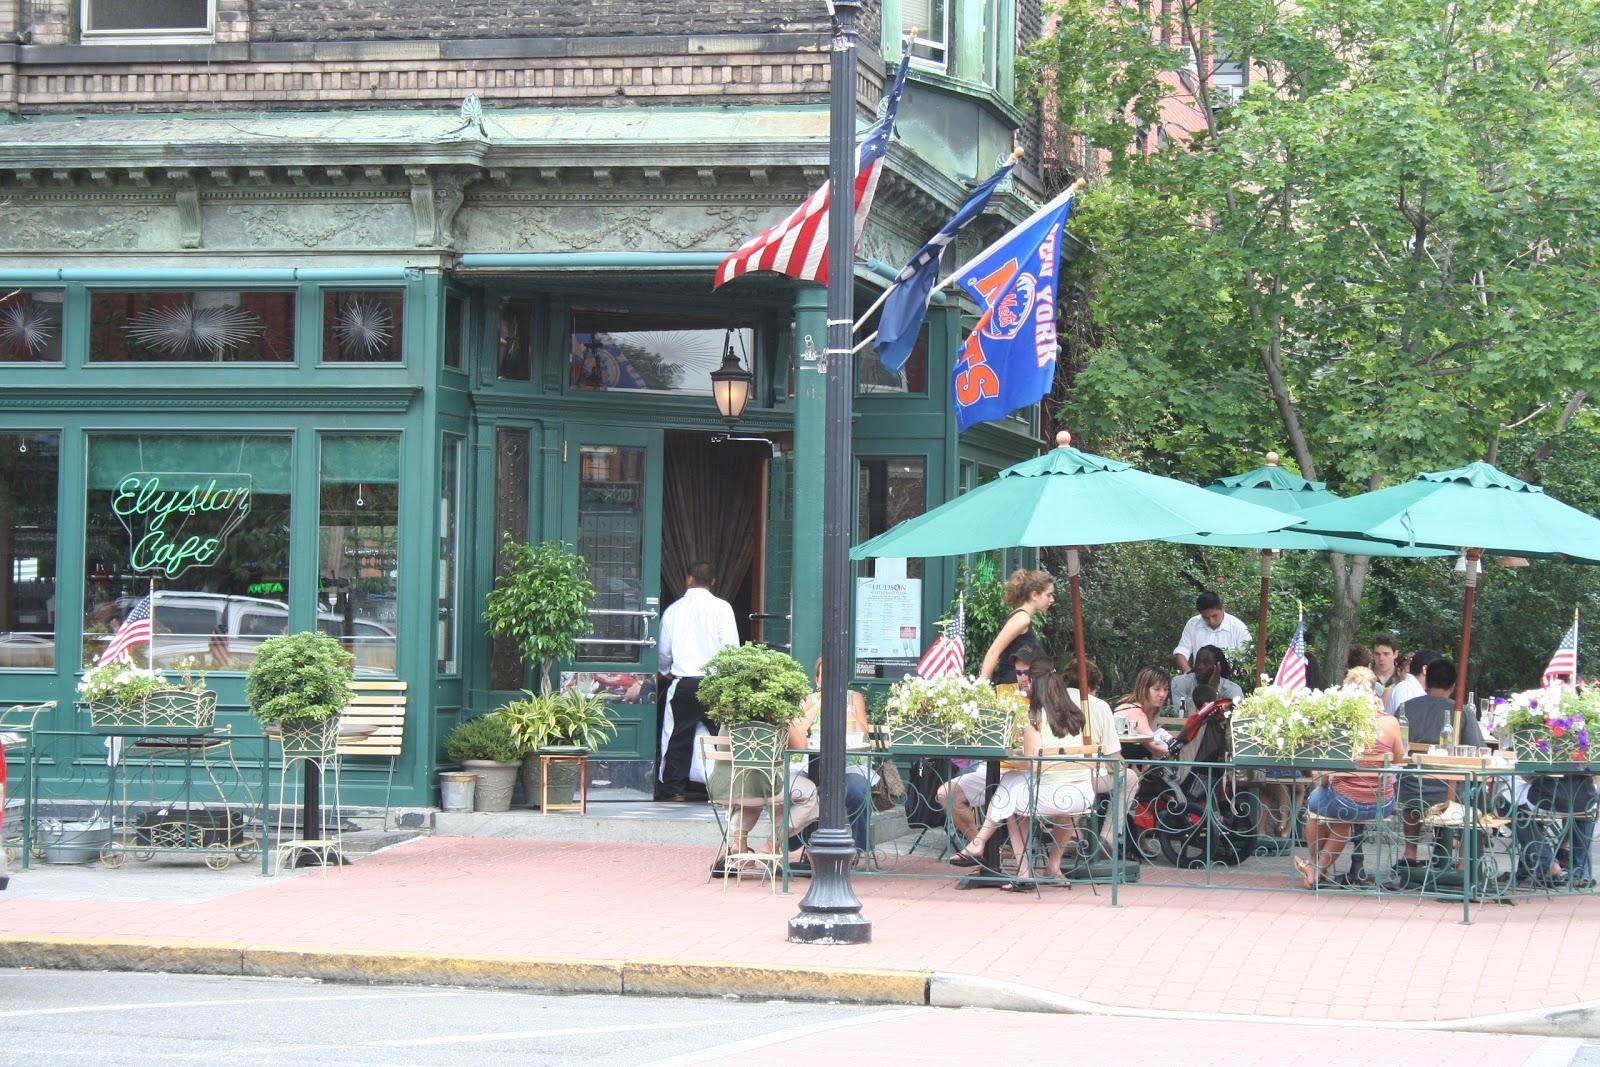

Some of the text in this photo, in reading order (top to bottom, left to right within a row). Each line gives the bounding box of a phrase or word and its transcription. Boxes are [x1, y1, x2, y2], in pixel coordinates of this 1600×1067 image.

[955, 257, 1019, 407] MTS
[998, 293, 1018, 328] Mets
[1035, 285, 1057, 368] YORK
[114, 477, 250, 531] Elysian
